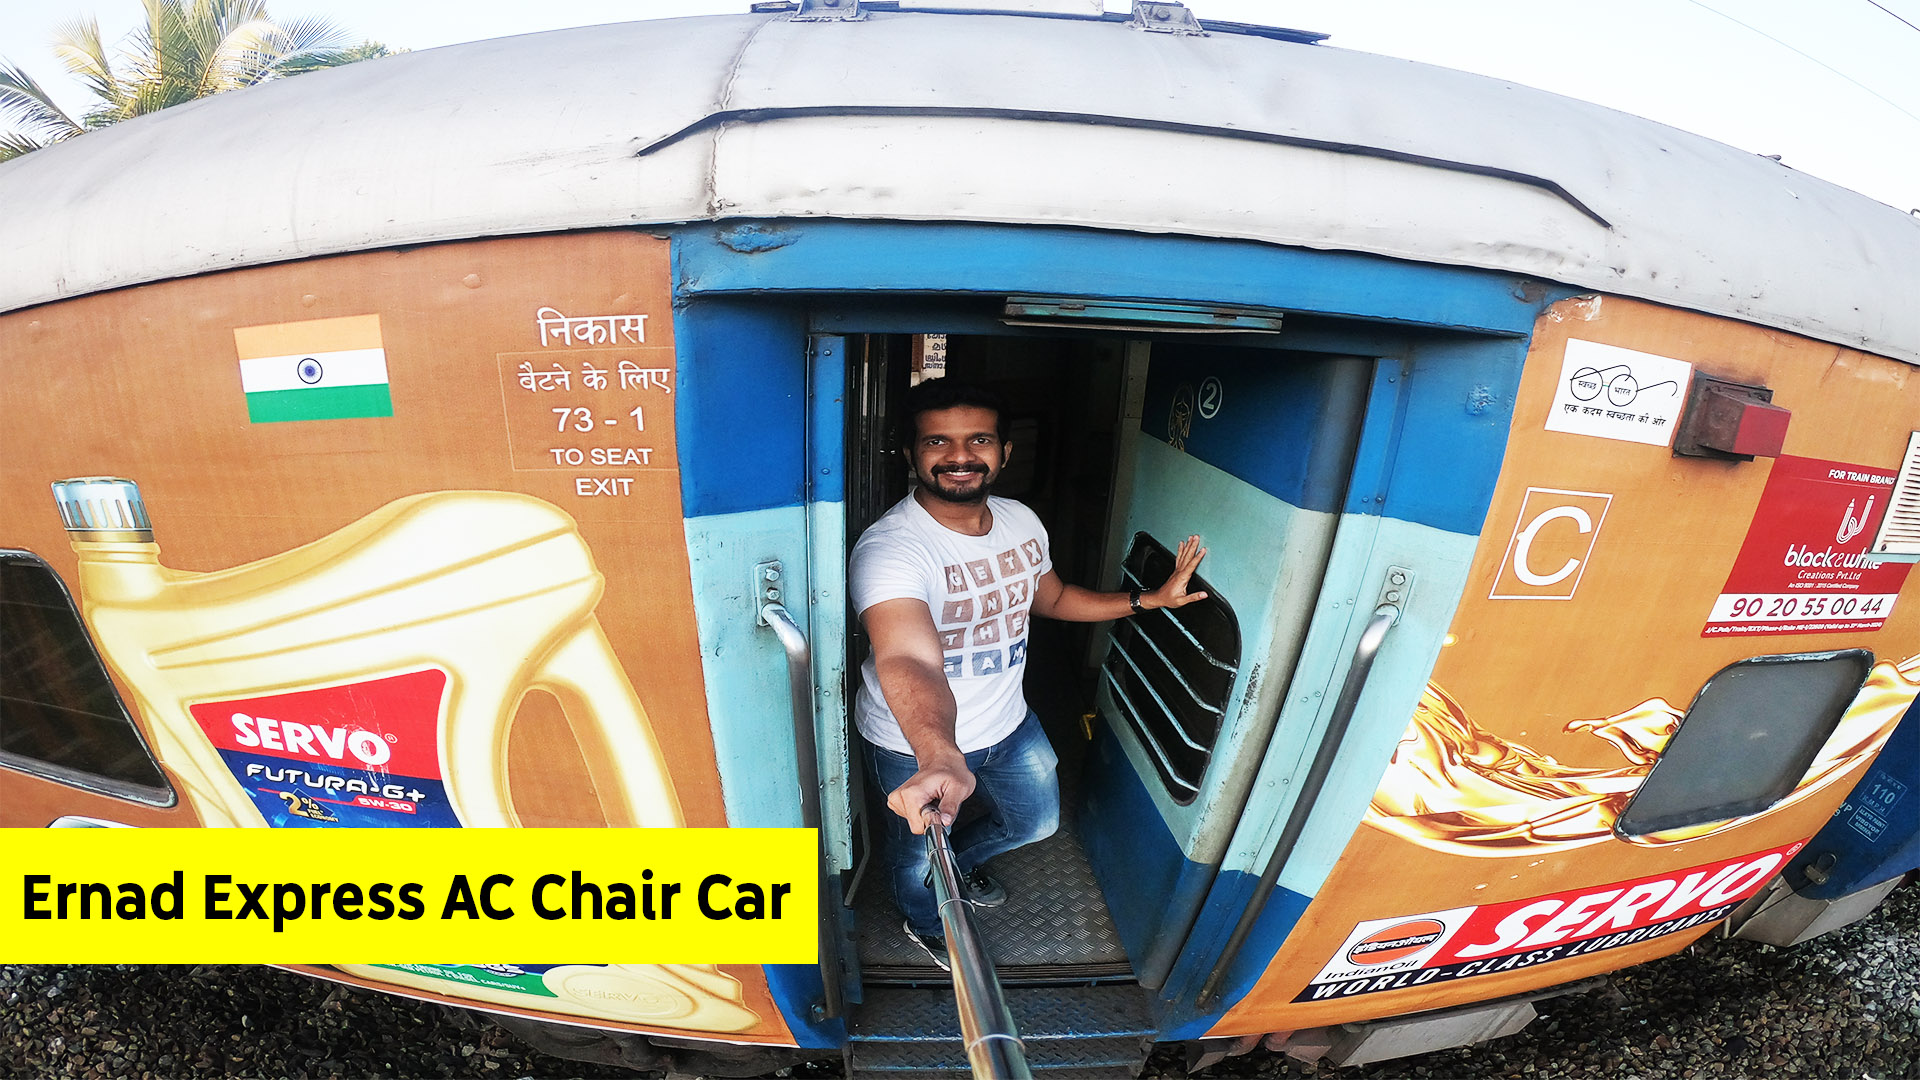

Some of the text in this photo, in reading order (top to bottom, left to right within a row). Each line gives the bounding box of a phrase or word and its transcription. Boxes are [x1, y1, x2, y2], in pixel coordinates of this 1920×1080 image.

[536, 306, 649, 347] निकास
[581, 361, 608, 391] के
[617, 360, 672, 395] लिए
[1202, 382, 1217, 411] 2
[552, 407, 594, 433] 73
[629, 406, 644, 432] 1
[1564, 403, 1579, 414] एक
[1582, 406, 1604, 417] कदम
[550, 448, 653, 466] TO SEAT
[575, 477, 635, 497] EXIT
[1828, 469, 1847, 480] FOR
[1847, 471, 1871, 483] TRAIN
[1512, 505, 1592, 587] C
[1797, 569, 1834, 580] Creations
[1729, 597, 1884, 618] 90 20 55 00 44
[231, 712, 391, 766] SERVO
[357, 797, 414, 812] 5W-30
[1871, 783, 1896, 805] 110
[1453, 852, 1783, 958] SERVO
[1312, 904, 1732, 1000] WORLD-CLASS LUBRICANTS
[1325, 959, 1419, 980] IndianOil
